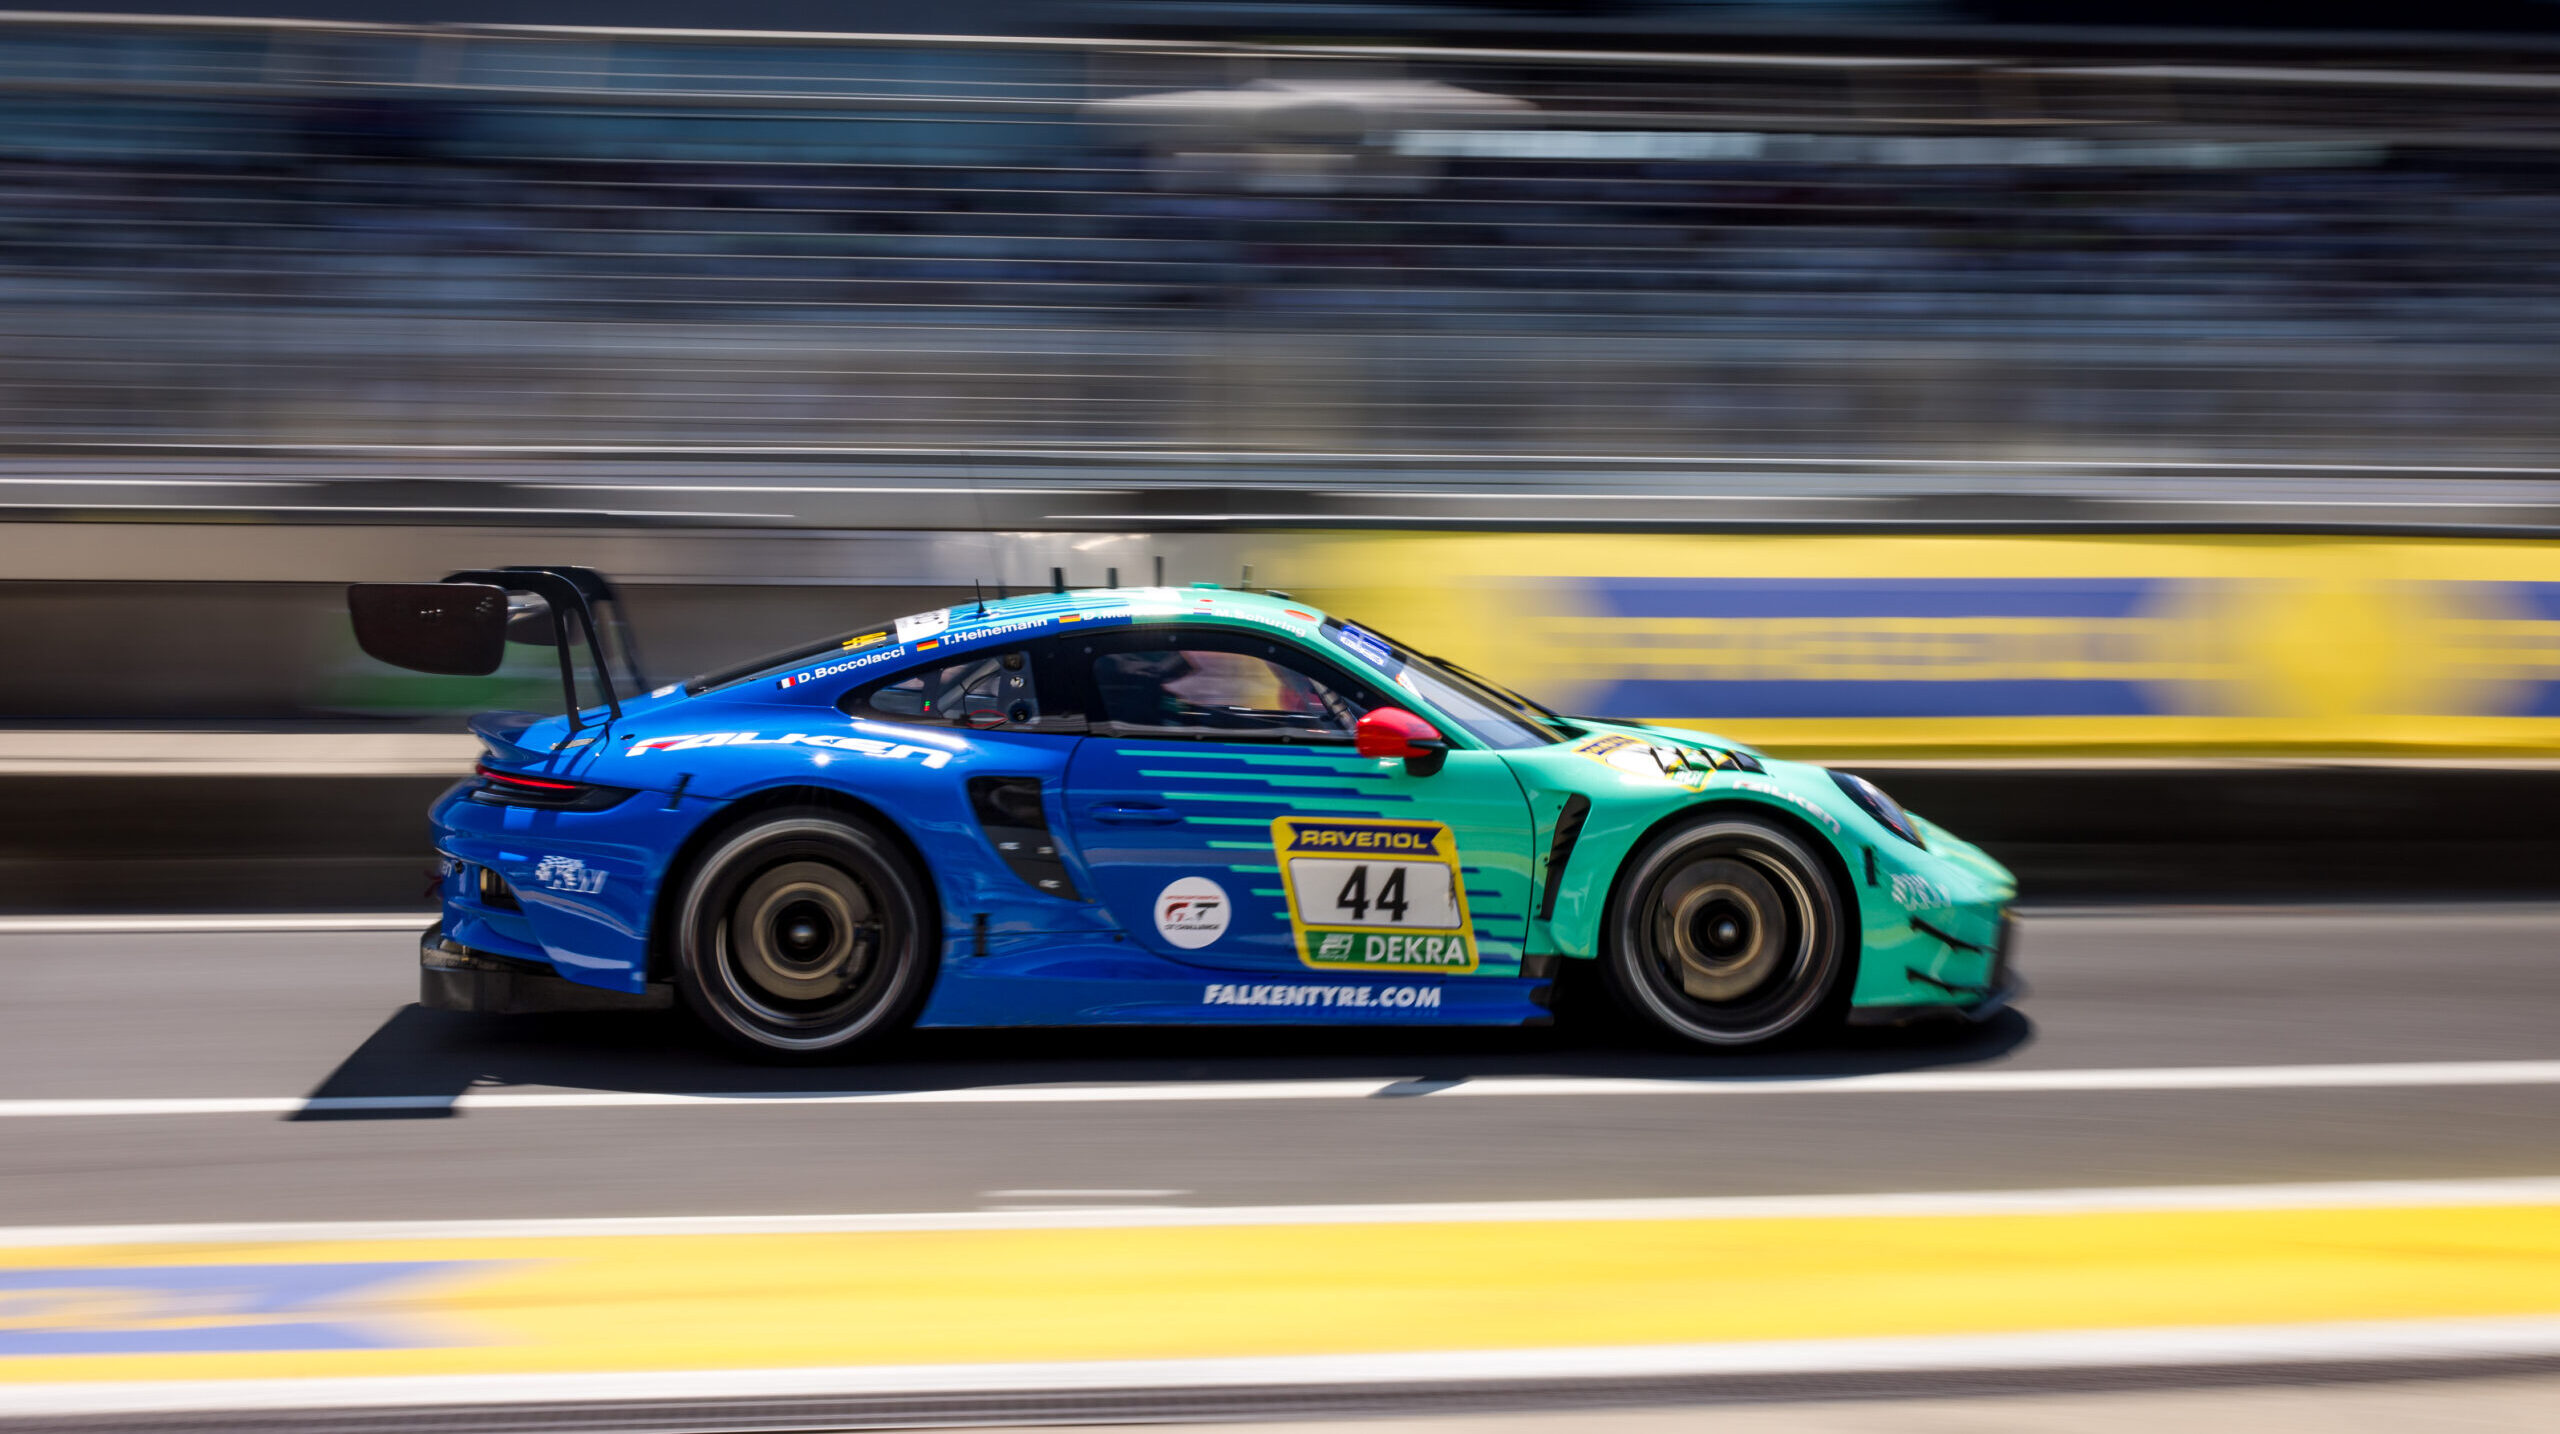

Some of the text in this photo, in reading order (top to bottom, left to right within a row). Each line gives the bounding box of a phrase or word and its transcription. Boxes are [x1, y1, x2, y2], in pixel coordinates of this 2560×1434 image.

[940, 619, 1048, 646] T.Heinemann
[797, 645, 905, 684] D.Boccolacci
[625, 732, 953, 769] FALKEN
[1301, 830, 1429, 849] RAVENOL
[1335, 865, 1409, 922] 44
[1365, 936, 1466, 964] DEKRA
[1203, 984, 1441, 1008] FALKENTYRE.COM
